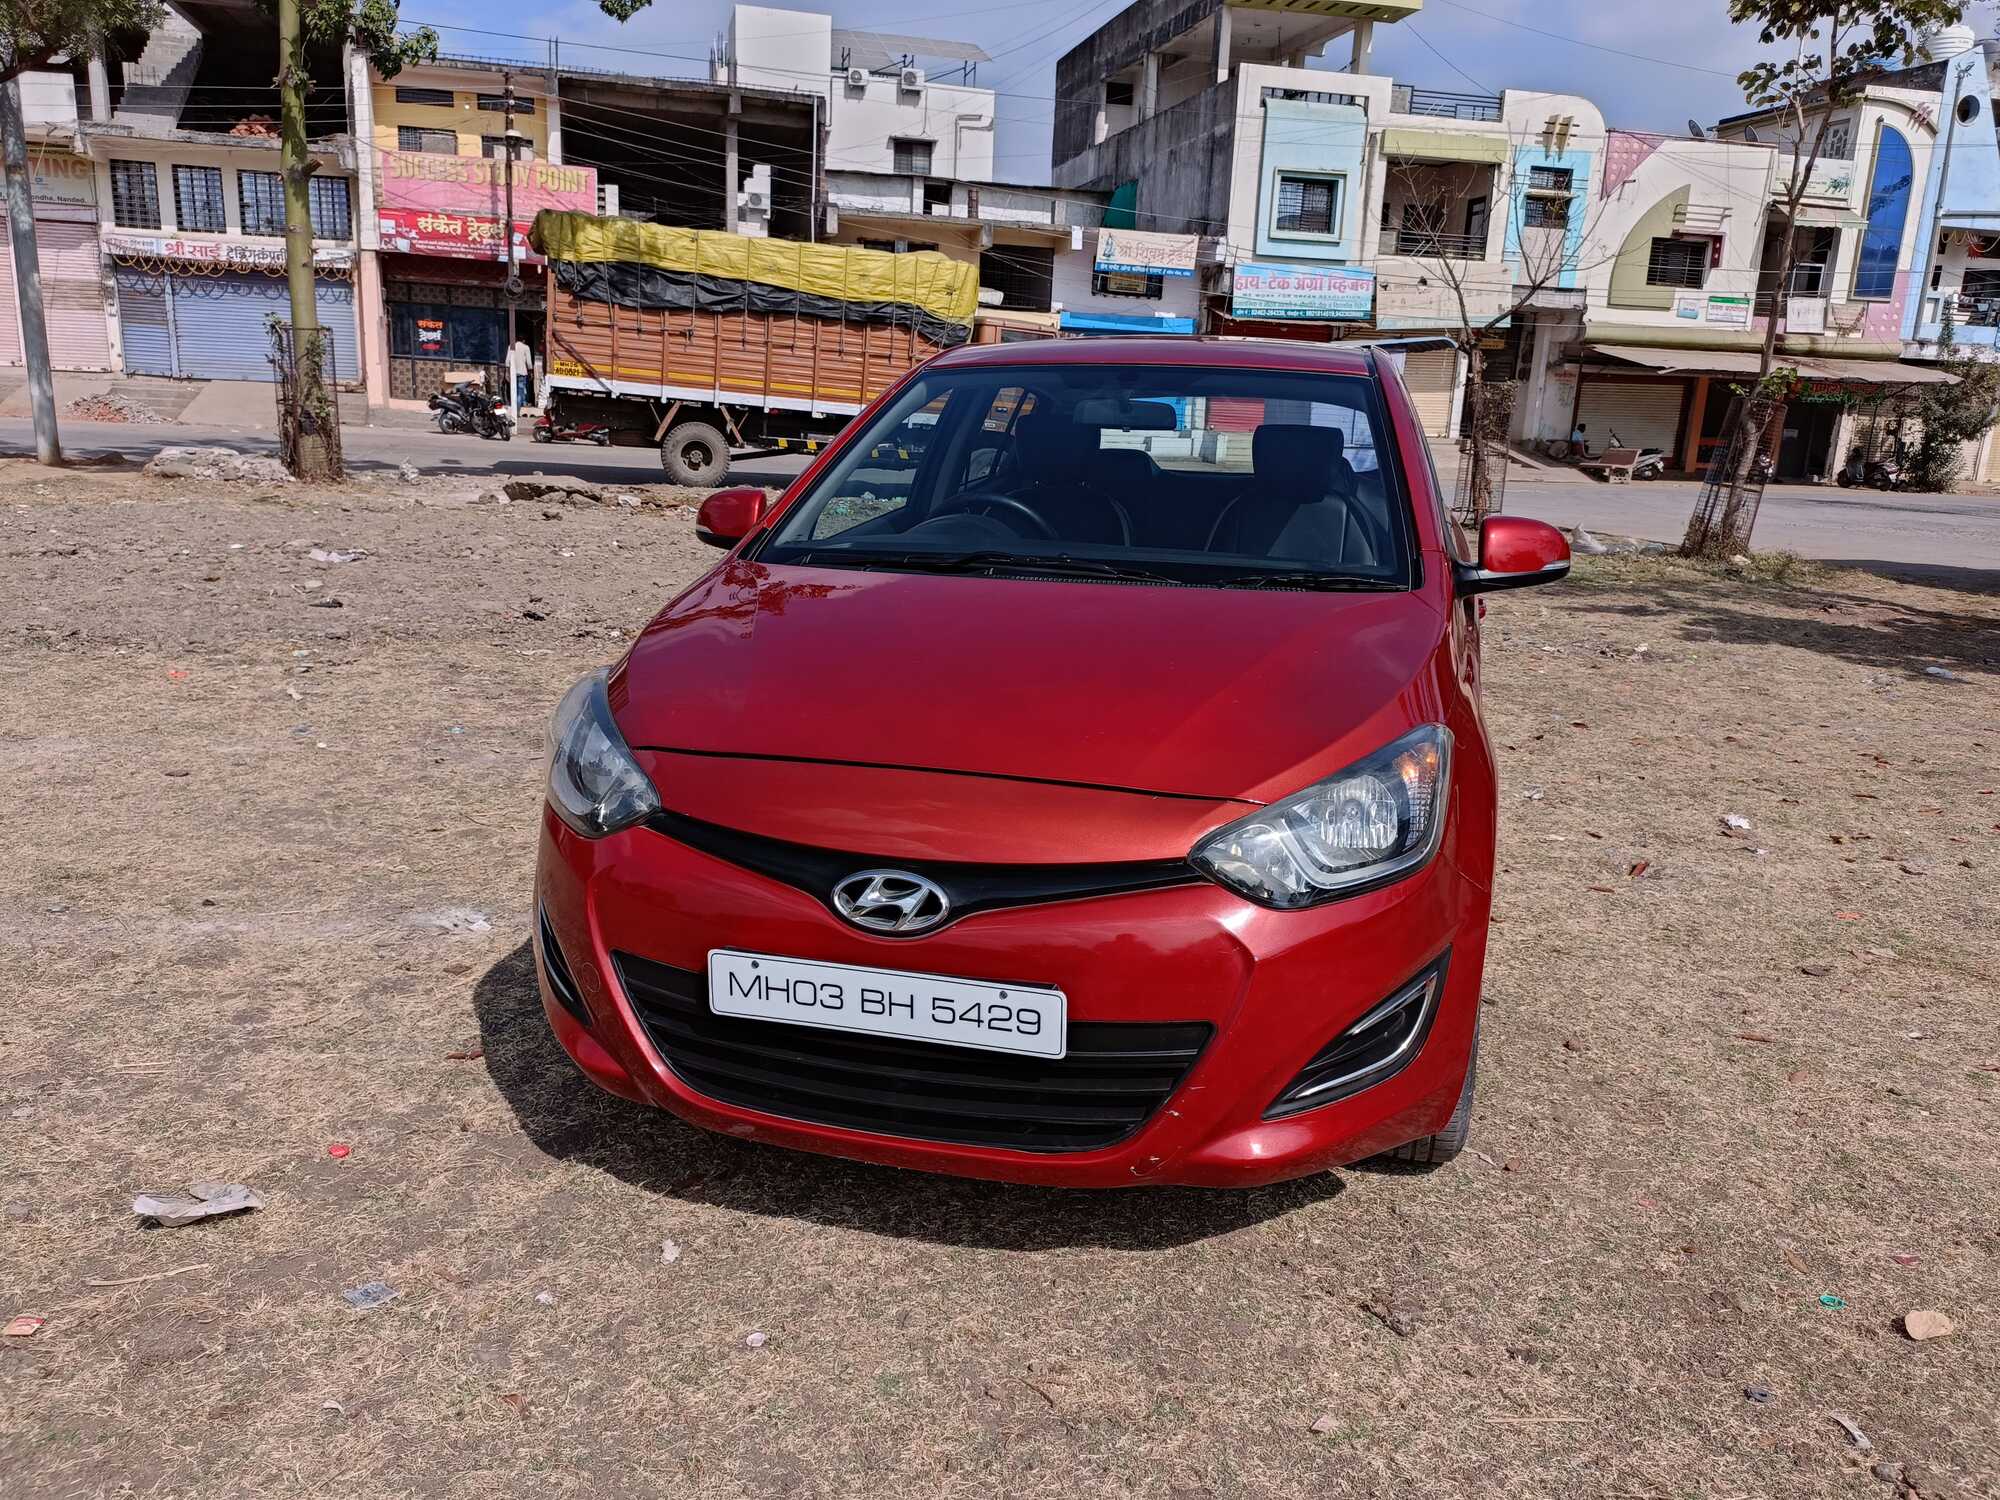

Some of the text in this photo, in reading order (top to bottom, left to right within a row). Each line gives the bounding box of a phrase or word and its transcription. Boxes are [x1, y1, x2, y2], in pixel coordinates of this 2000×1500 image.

[390, 154, 468, 183] SUCCESS
[535, 167, 589, 193] POINT
[417, 213, 462, 236] संकेत
[466, 217, 507, 241] ट्रेडर्स
[164, 241, 185, 256] श्री
[187, 243, 221, 259] साई
[1118, 241, 1133, 258] श्री
[729, 971, 1042, 1036] MH03 BH 5429
